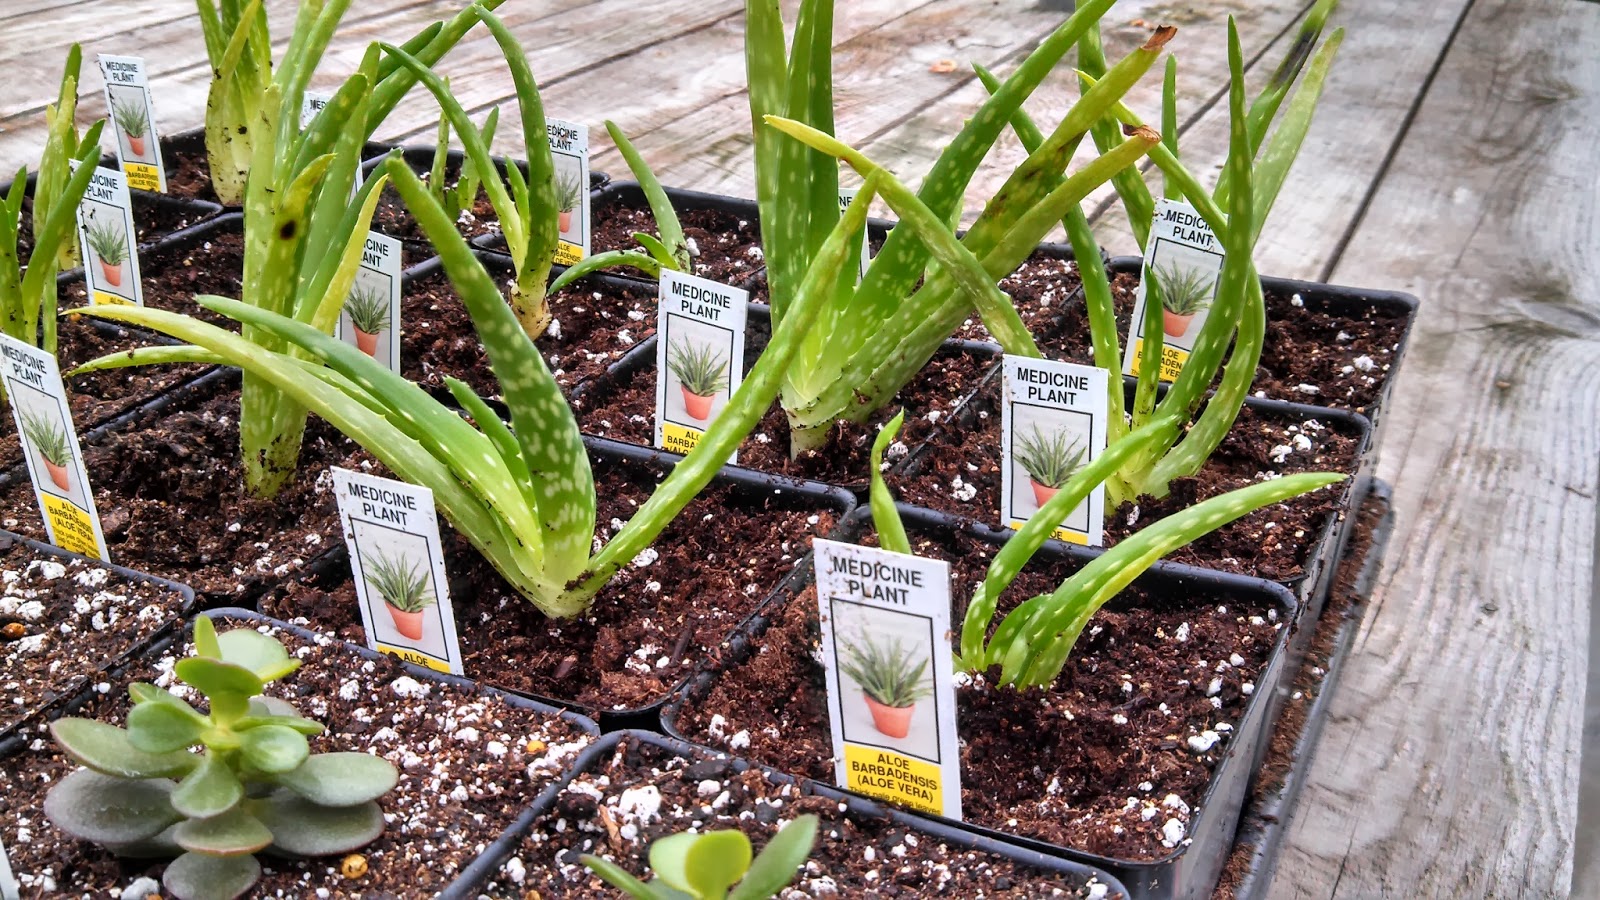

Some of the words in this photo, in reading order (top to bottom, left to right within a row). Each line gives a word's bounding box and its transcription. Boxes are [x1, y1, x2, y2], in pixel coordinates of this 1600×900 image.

[106, 62, 138, 72] MEDICINE
[112, 73, 134, 82] PLANT
[547, 125, 578, 140] EDICINE
[91, 174, 118, 190] DICINE
[87, 185, 113, 201] PLANT
[1166, 210, 1210, 231] MEDICI
[1172, 226, 1214, 246] PLANT
[364, 238, 388, 256] CINE
[558, 244, 570, 252] LOE
[362, 252, 382, 267] ANT
[672, 281, 730, 308] MEDICINE
[682, 300, 720, 320] PLANT
[0, 344, 47, 374] MEDICINE
[1162, 348, 1180, 360] LOE
[12, 363, 44, 387] PLANT
[1018, 367, 1088, 390] MEDICINE
[1028, 386, 1076, 405] PLANT
[348, 482, 417, 510] MEDICINE
[363, 502, 407, 526] PLANT
[833, 556, 922, 588] MEDICINE
[850, 580, 909, 605] PLANT
[404, 653, 428, 667] ALOE
[878, 754, 910, 770] ALOE
[852, 761, 938, 790] BARBADENSIS
[858, 774, 894, 790] (ALOE
[898, 782, 934, 803] VERA)
